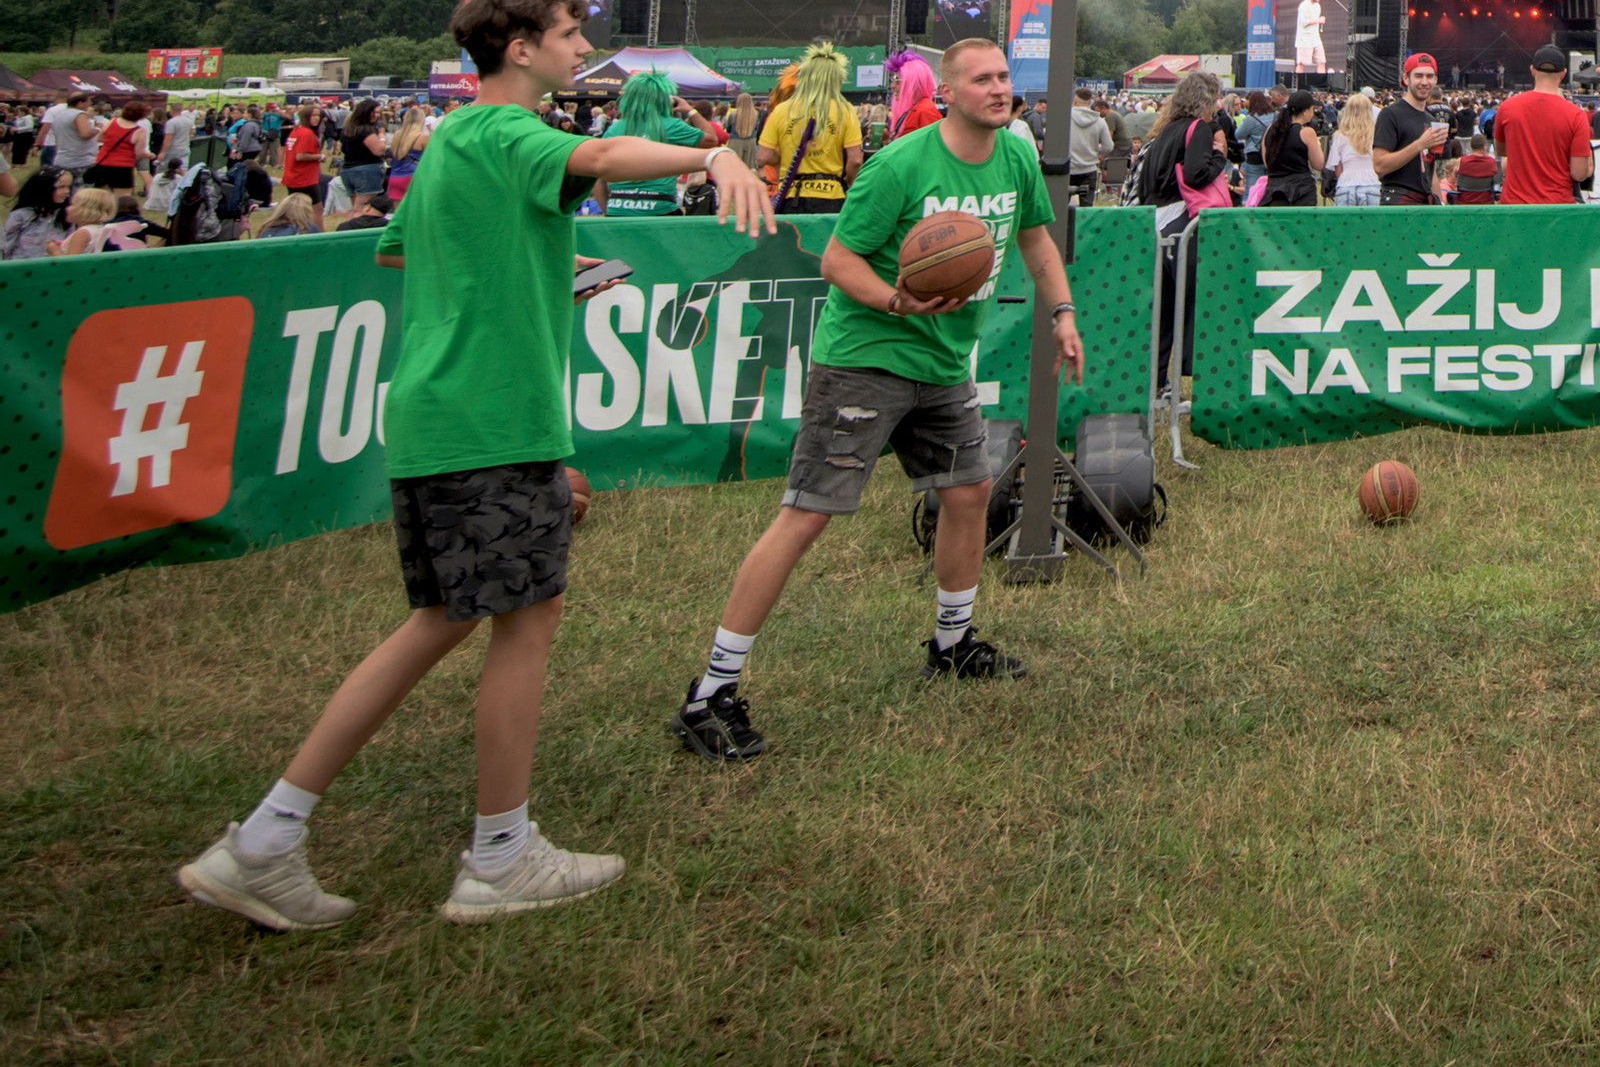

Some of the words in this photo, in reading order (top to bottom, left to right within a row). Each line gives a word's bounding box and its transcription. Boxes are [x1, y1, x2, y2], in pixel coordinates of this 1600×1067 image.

[805, 180, 834, 191] CRAZY
[622, 199, 657, 211] CRAZY
[922, 190, 1018, 219] MAKE
[1253, 253, 1562, 334] ZAŽIJ
[1250, 347, 1370, 397] NA
